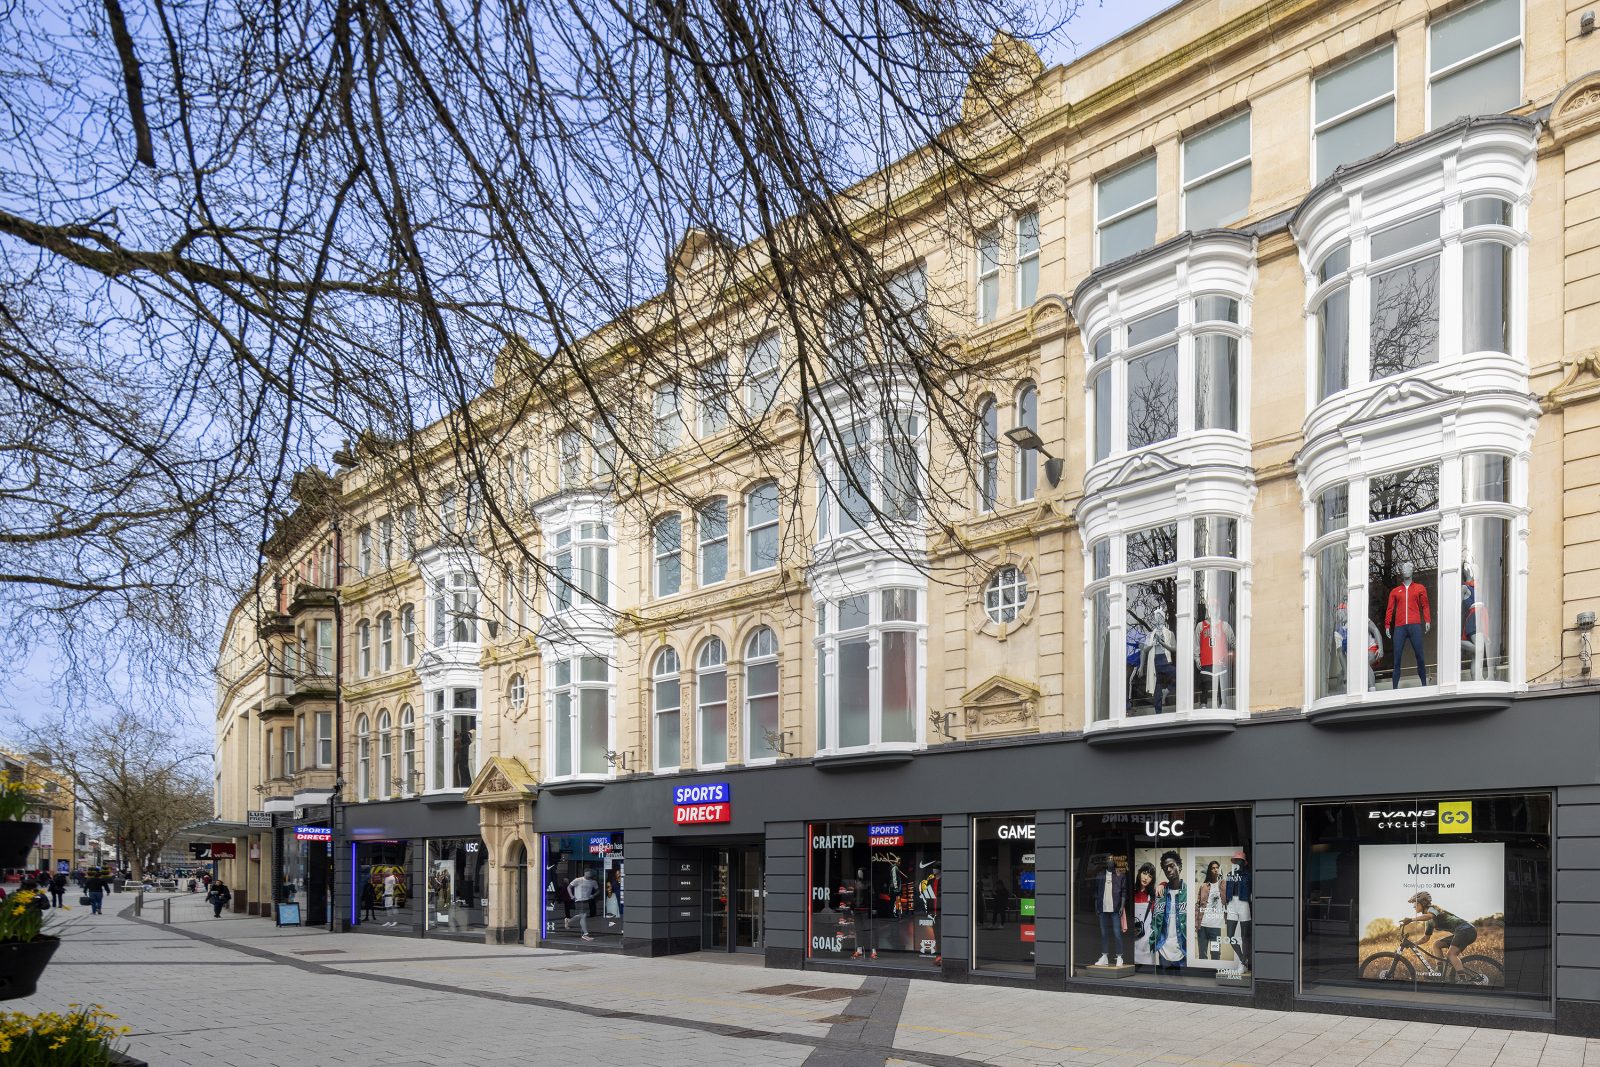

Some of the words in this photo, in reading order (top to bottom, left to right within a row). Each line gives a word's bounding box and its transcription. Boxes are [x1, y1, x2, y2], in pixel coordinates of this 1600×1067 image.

[676, 785, 723, 802] SPORTS
[676, 805, 723, 822] DIRECT
[1368, 809, 1437, 819] EVANS
[871, 826, 900, 835] SPORTS
[997, 824, 1036, 839] GAME
[1145, 820, 1185, 837] USC
[1378, 821, 1426, 829] CYCLES
[465, 843, 479, 852] USC
[812, 834, 855, 849] CRAFTED
[871, 837, 900, 845] DIRECT
[1407, 863, 1451, 875] Marlin
[812, 886, 831, 901] FOR
[812, 935, 842, 952] GOALS
